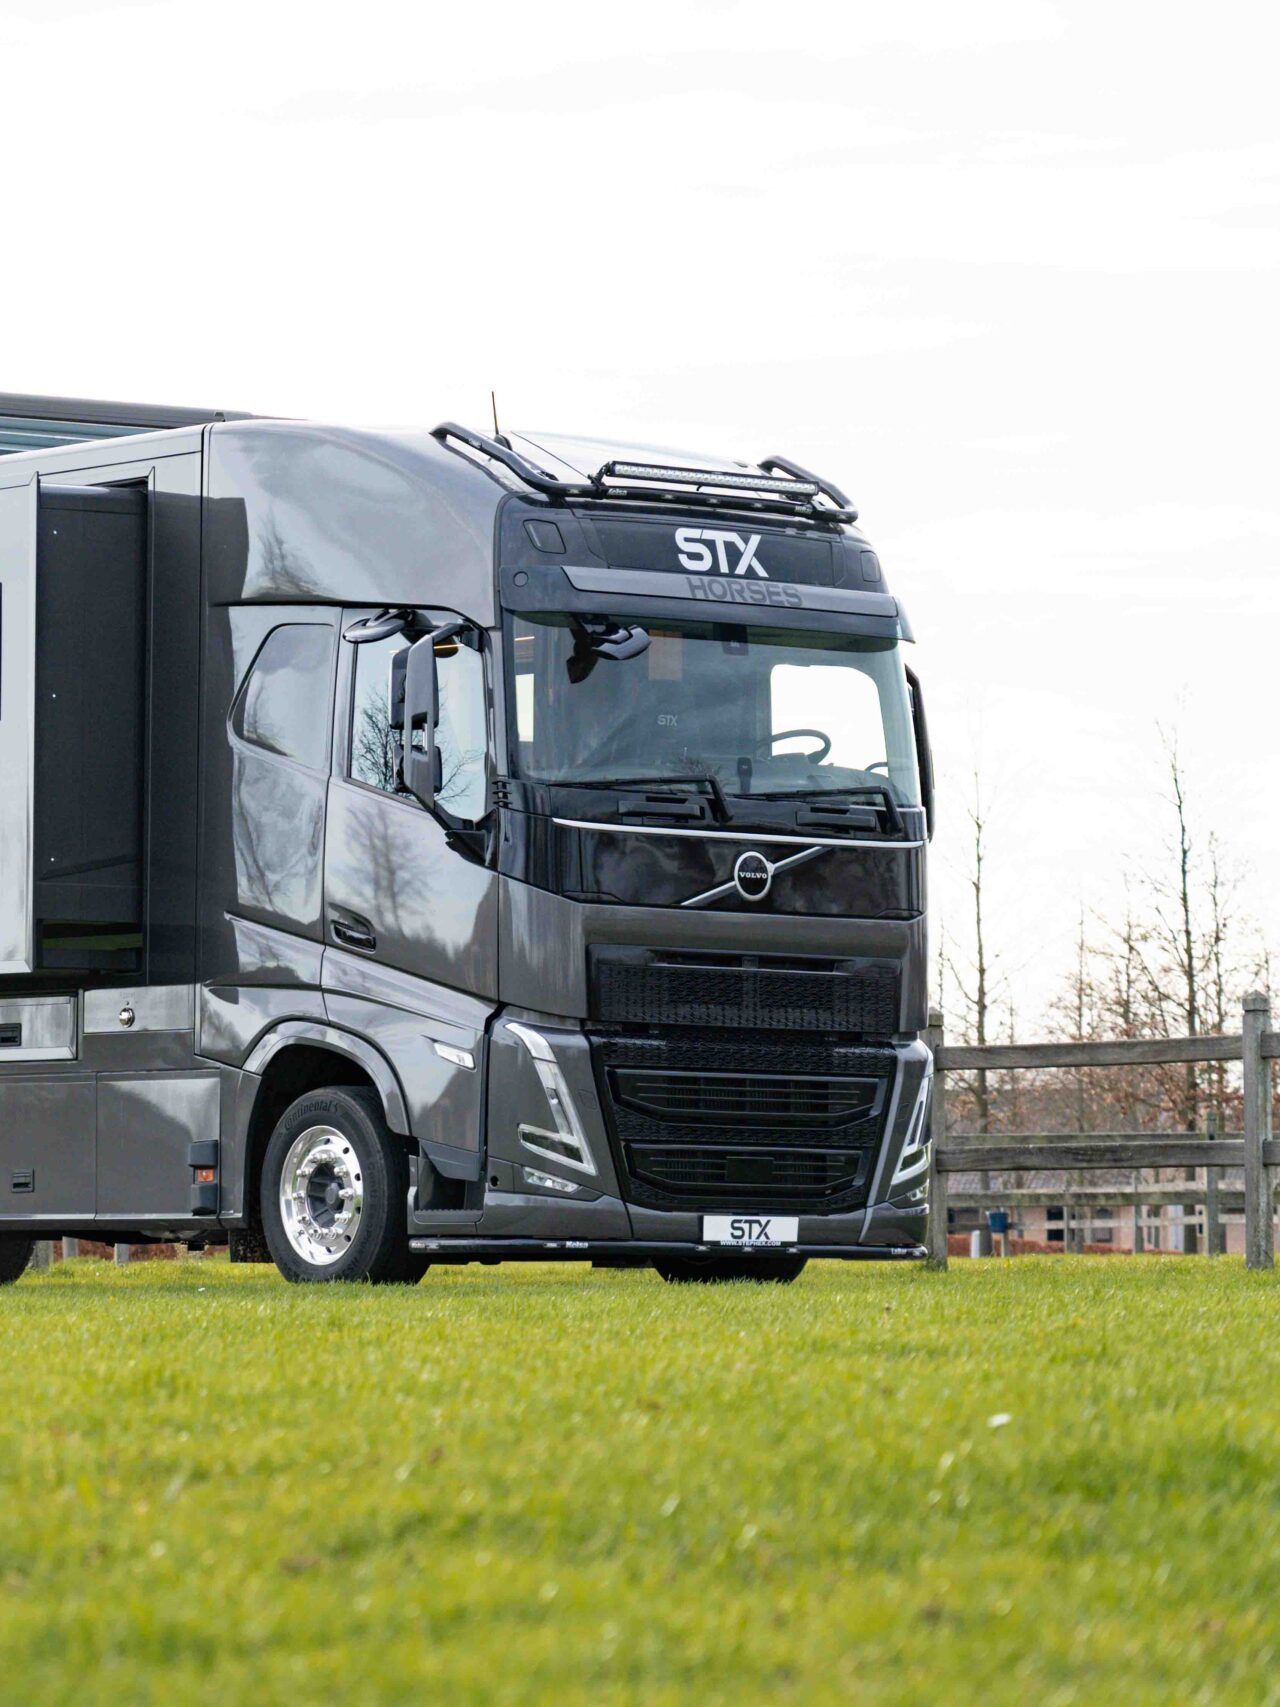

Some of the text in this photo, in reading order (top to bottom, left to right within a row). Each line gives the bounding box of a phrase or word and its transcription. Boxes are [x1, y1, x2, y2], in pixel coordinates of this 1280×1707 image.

[675, 527, 769, 578] STX
[686, 577, 803, 607] HORSES
[656, 714, 678, 727] STX
[739, 871, 768, 879] VOLVO
[284, 1100, 333, 1131] Continental
[730, 1219, 771, 1240] STX
